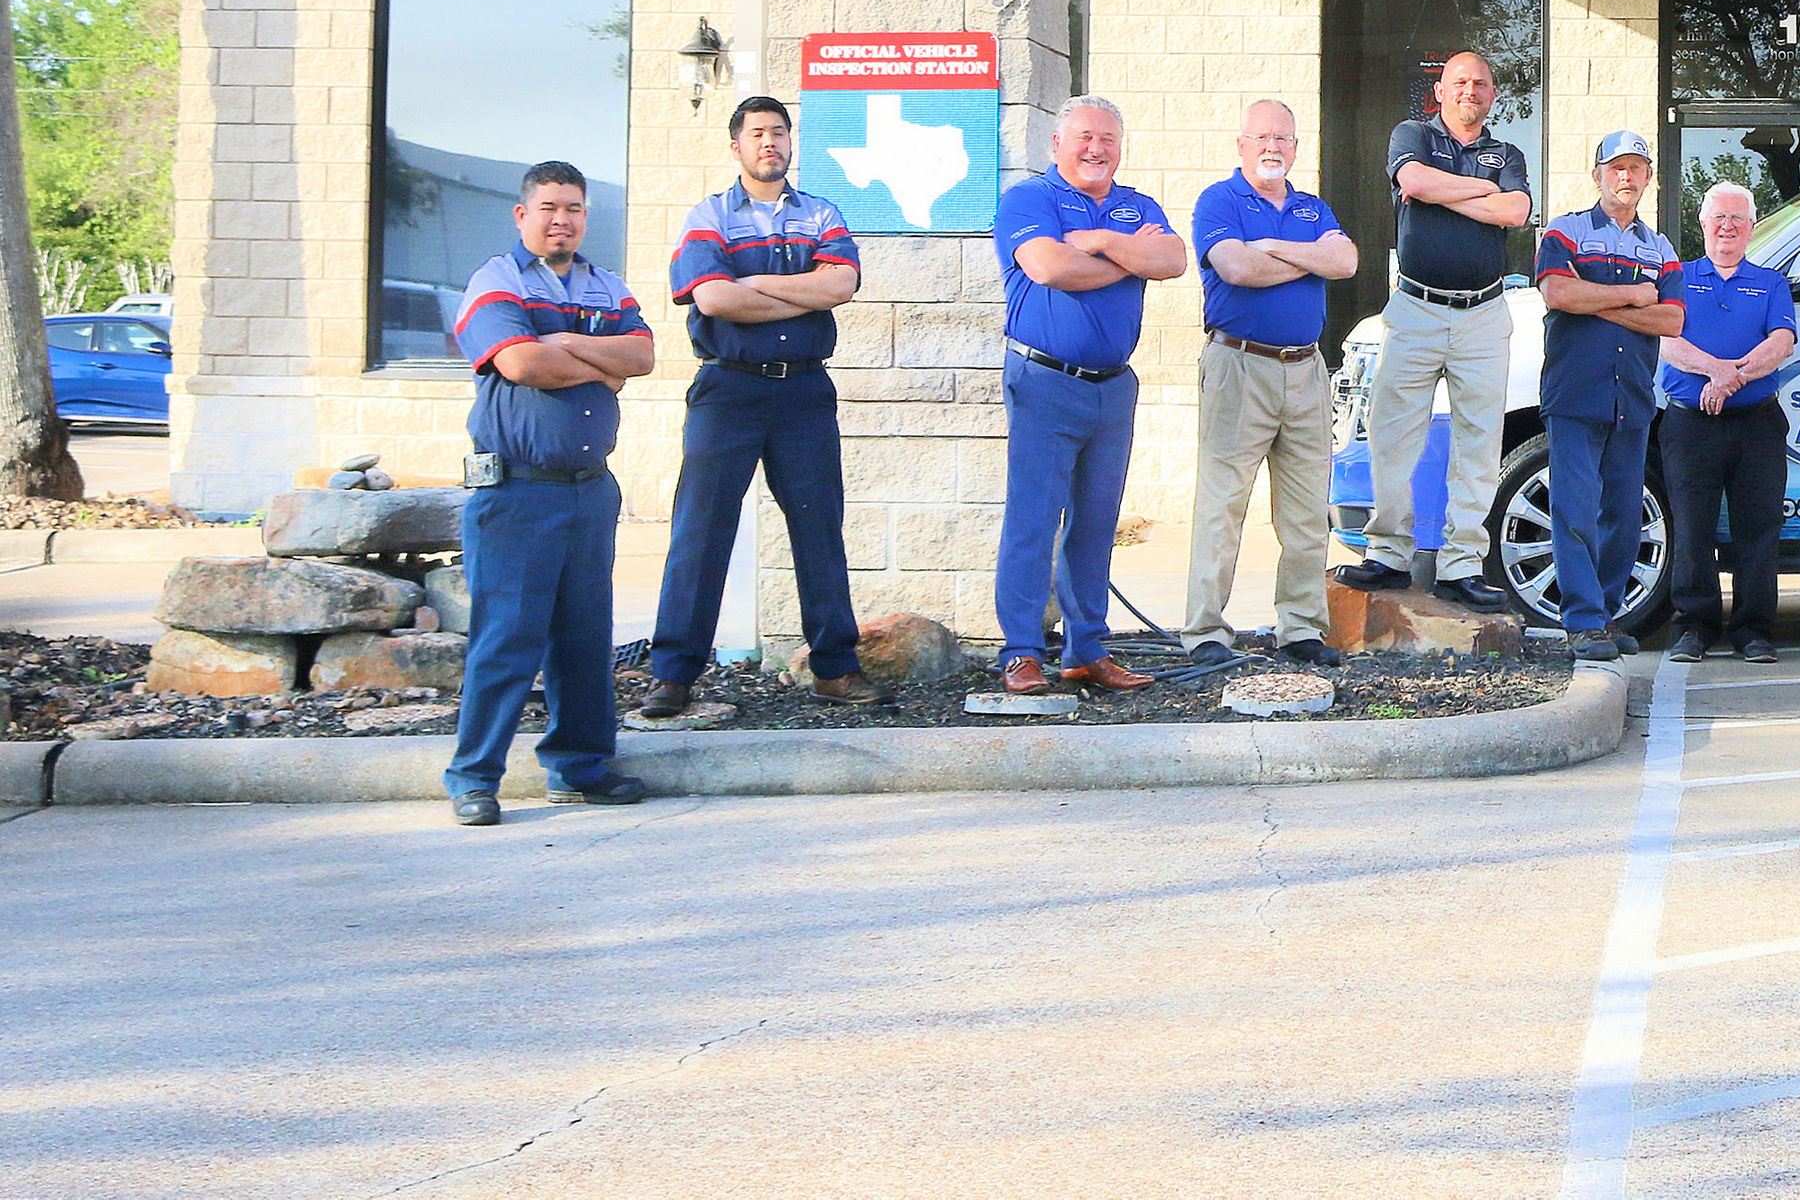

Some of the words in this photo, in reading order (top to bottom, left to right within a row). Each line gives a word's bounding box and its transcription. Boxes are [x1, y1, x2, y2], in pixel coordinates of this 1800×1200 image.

[820, 45, 901, 59] OFFICIAL
[902, 44, 978, 58] VEHICLE
[808, 61, 913, 76] INSPECTION
[914, 60, 990, 75] STATION
